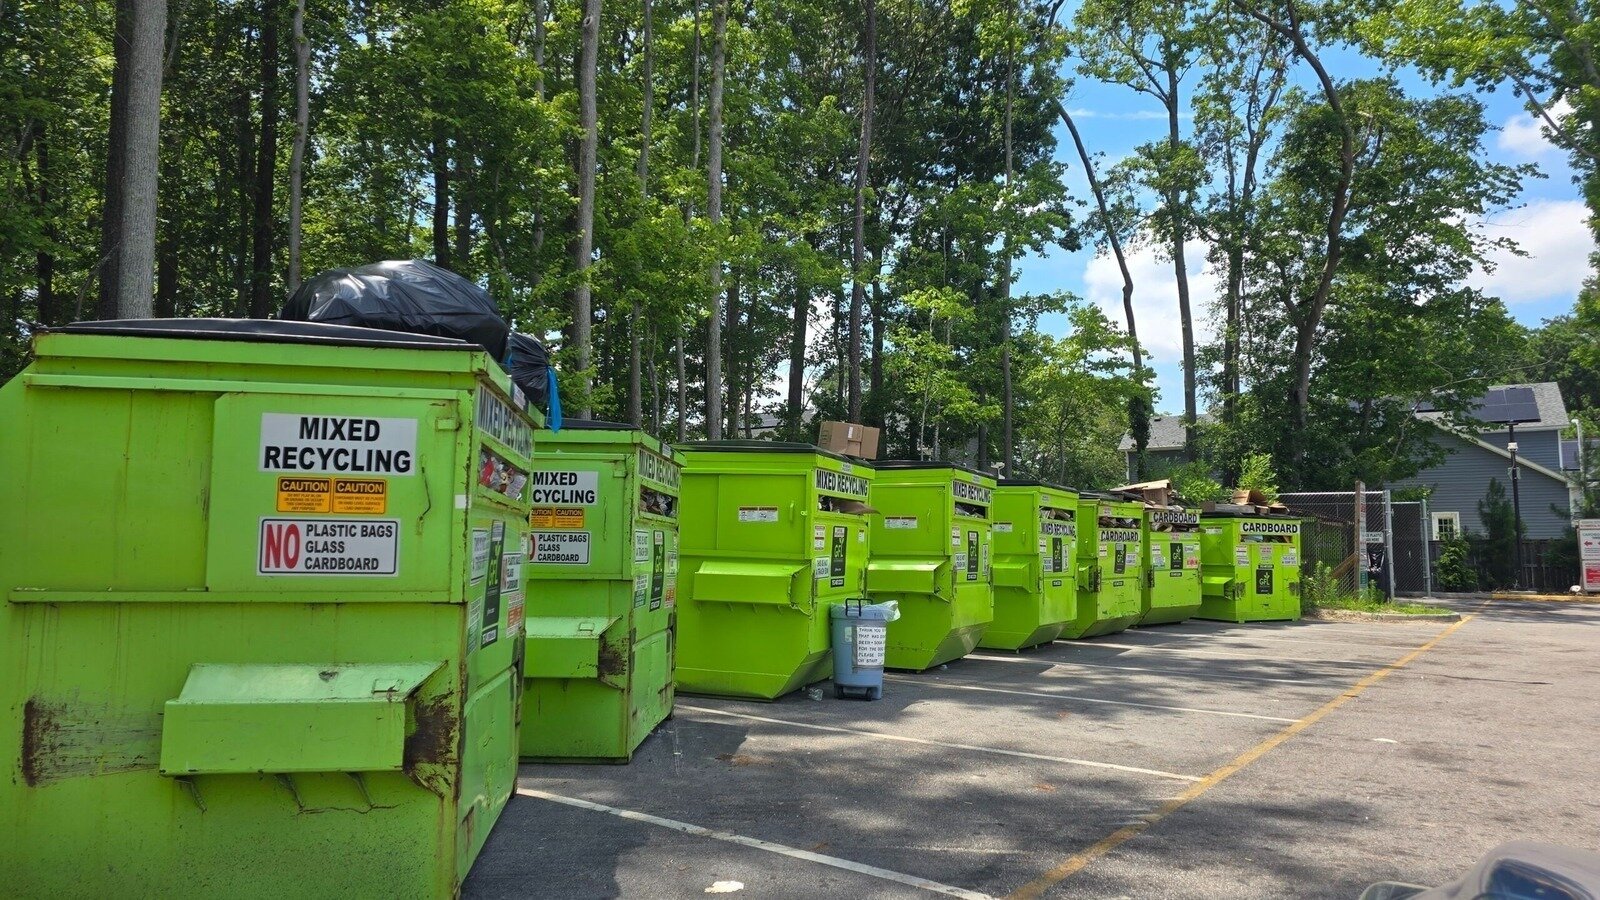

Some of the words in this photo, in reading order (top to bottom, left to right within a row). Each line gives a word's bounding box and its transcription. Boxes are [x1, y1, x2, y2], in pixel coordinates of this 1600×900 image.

[299, 416, 380, 442] MIXED
[263, 446, 411, 473] RECYCLING
[533, 472, 578, 486] MIXED
[816, 469, 836, 491] MIXED
[837, 474, 868, 496] RECYCLING
[281, 481, 328, 492] CAUTION
[337, 482, 383, 493] CAUTION
[532, 489, 595, 504] CYCLING
[1153, 511, 1197, 523] CARDBOARD
[306, 524, 357, 538] PLASTIC
[360, 525, 393, 538] BAGS
[1243, 522, 1298, 534] CARDBOARD
[538, 533, 567, 543] PLASTIC
[568, 534, 587, 543] BAGS
[1100, 530, 1138, 542] CARDBOARD
[264, 523, 300, 569] NO
[305, 540, 345, 554] GLASS
[538, 543, 560, 552] GLASS
[304, 557, 379, 571] CARDBOARD
[537, 553, 579, 562] CARDBOARD
[1259, 578, 1270, 586] GFL
